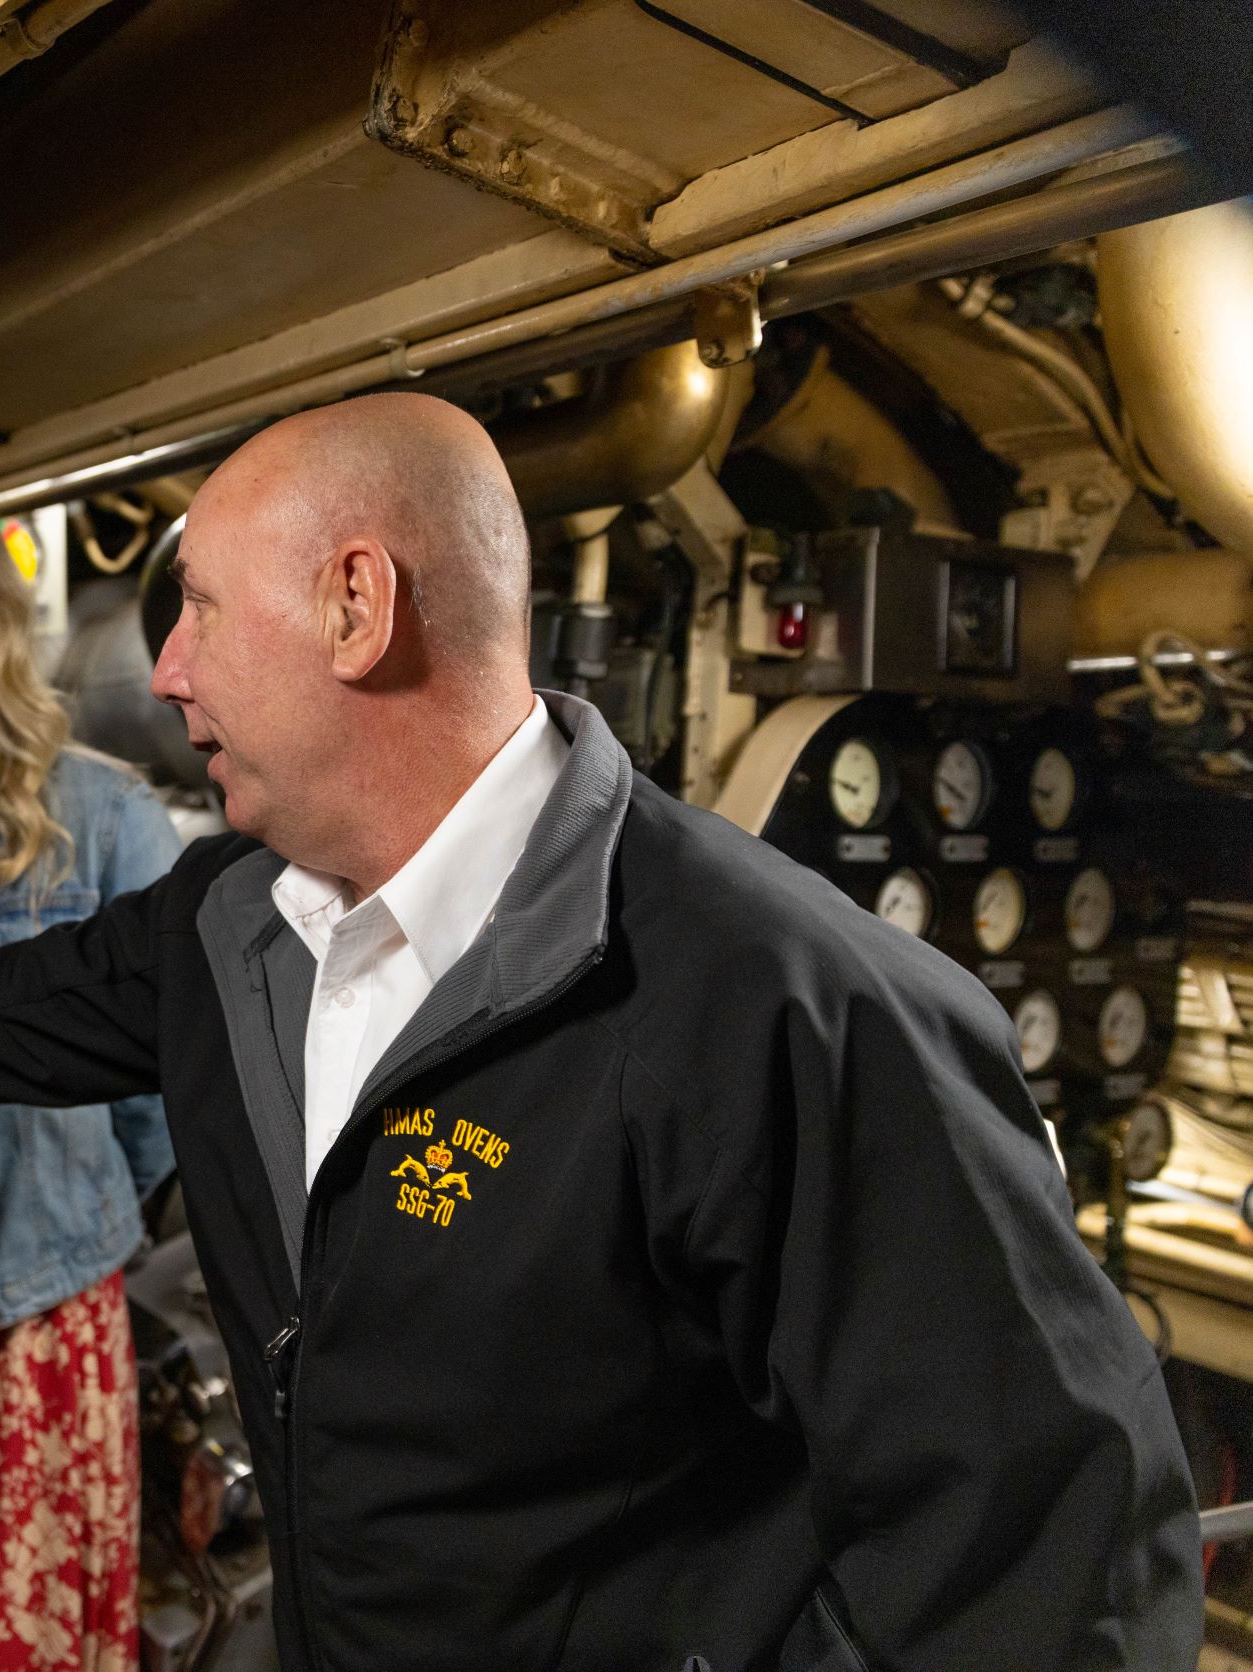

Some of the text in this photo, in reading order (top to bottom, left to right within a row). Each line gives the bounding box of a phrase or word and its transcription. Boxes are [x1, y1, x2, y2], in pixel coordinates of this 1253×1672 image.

[383, 1108, 510, 1169] HMAS OVENS
[397, 1183, 456, 1227] SSG-70
